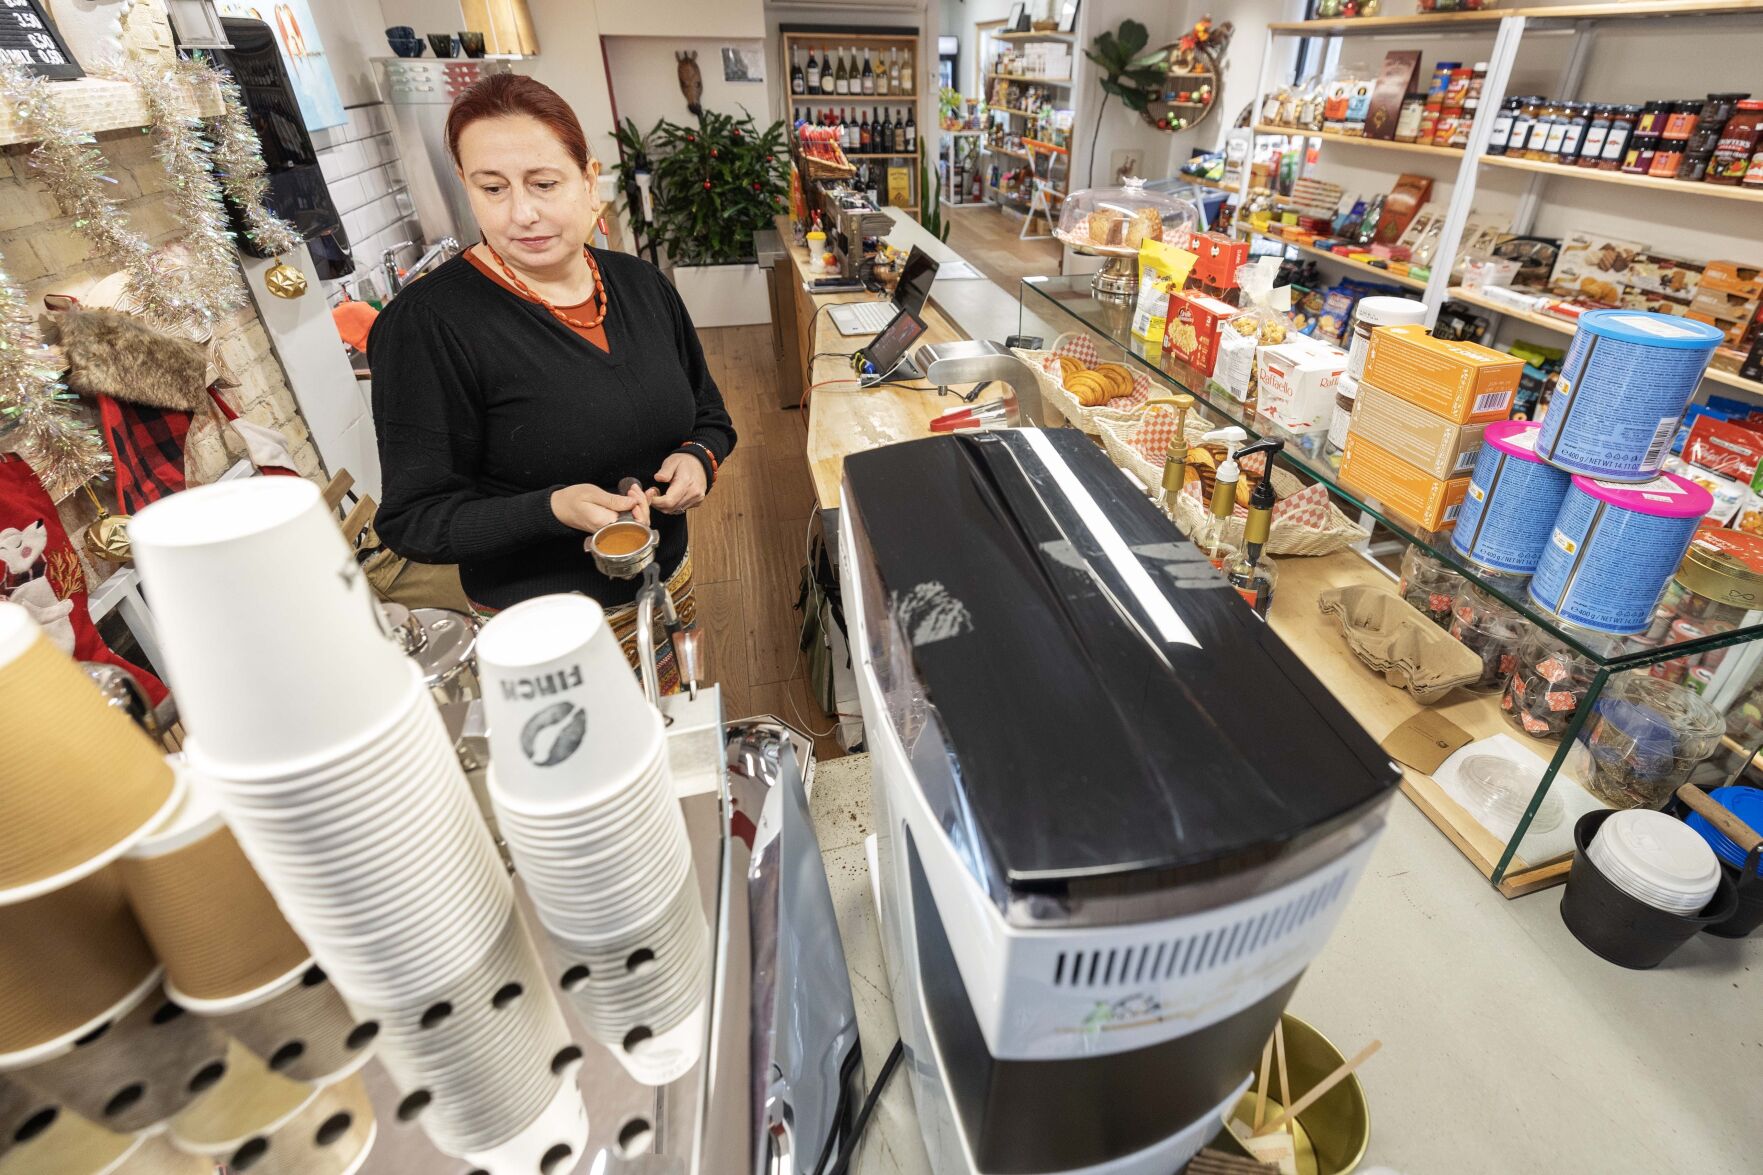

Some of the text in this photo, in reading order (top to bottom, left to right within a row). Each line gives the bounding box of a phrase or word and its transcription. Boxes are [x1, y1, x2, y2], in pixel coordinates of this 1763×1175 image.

[1260, 368, 1293, 397] Raffaello
[1568, 450, 1579, 460] 400
[1588, 457, 1601, 466] NET
